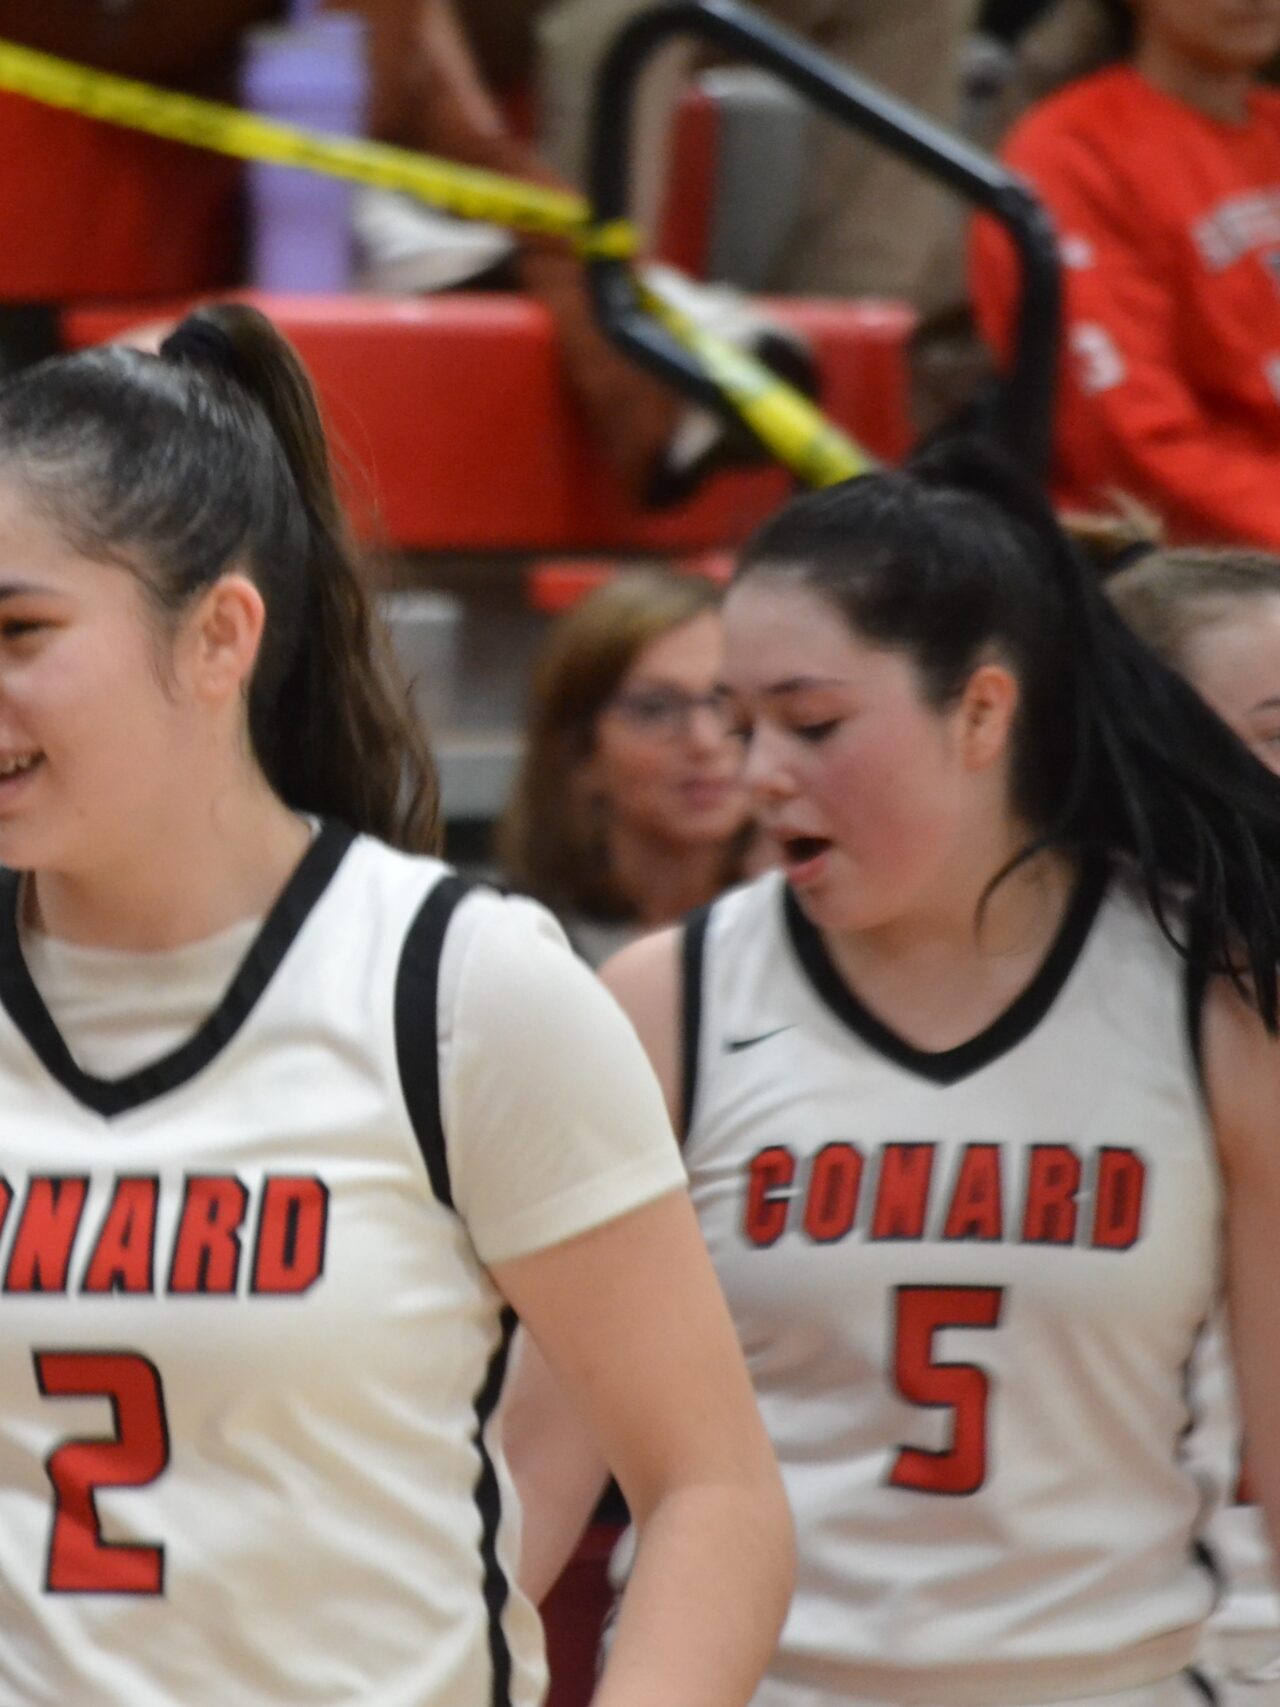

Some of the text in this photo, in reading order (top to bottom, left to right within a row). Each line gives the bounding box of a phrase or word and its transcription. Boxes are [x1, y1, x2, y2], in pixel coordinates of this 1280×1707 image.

[743, 1142, 1146, 1251] CONARD
[32, 1349, 169, 1597] 2
[884, 1284, 1006, 1496] 5
